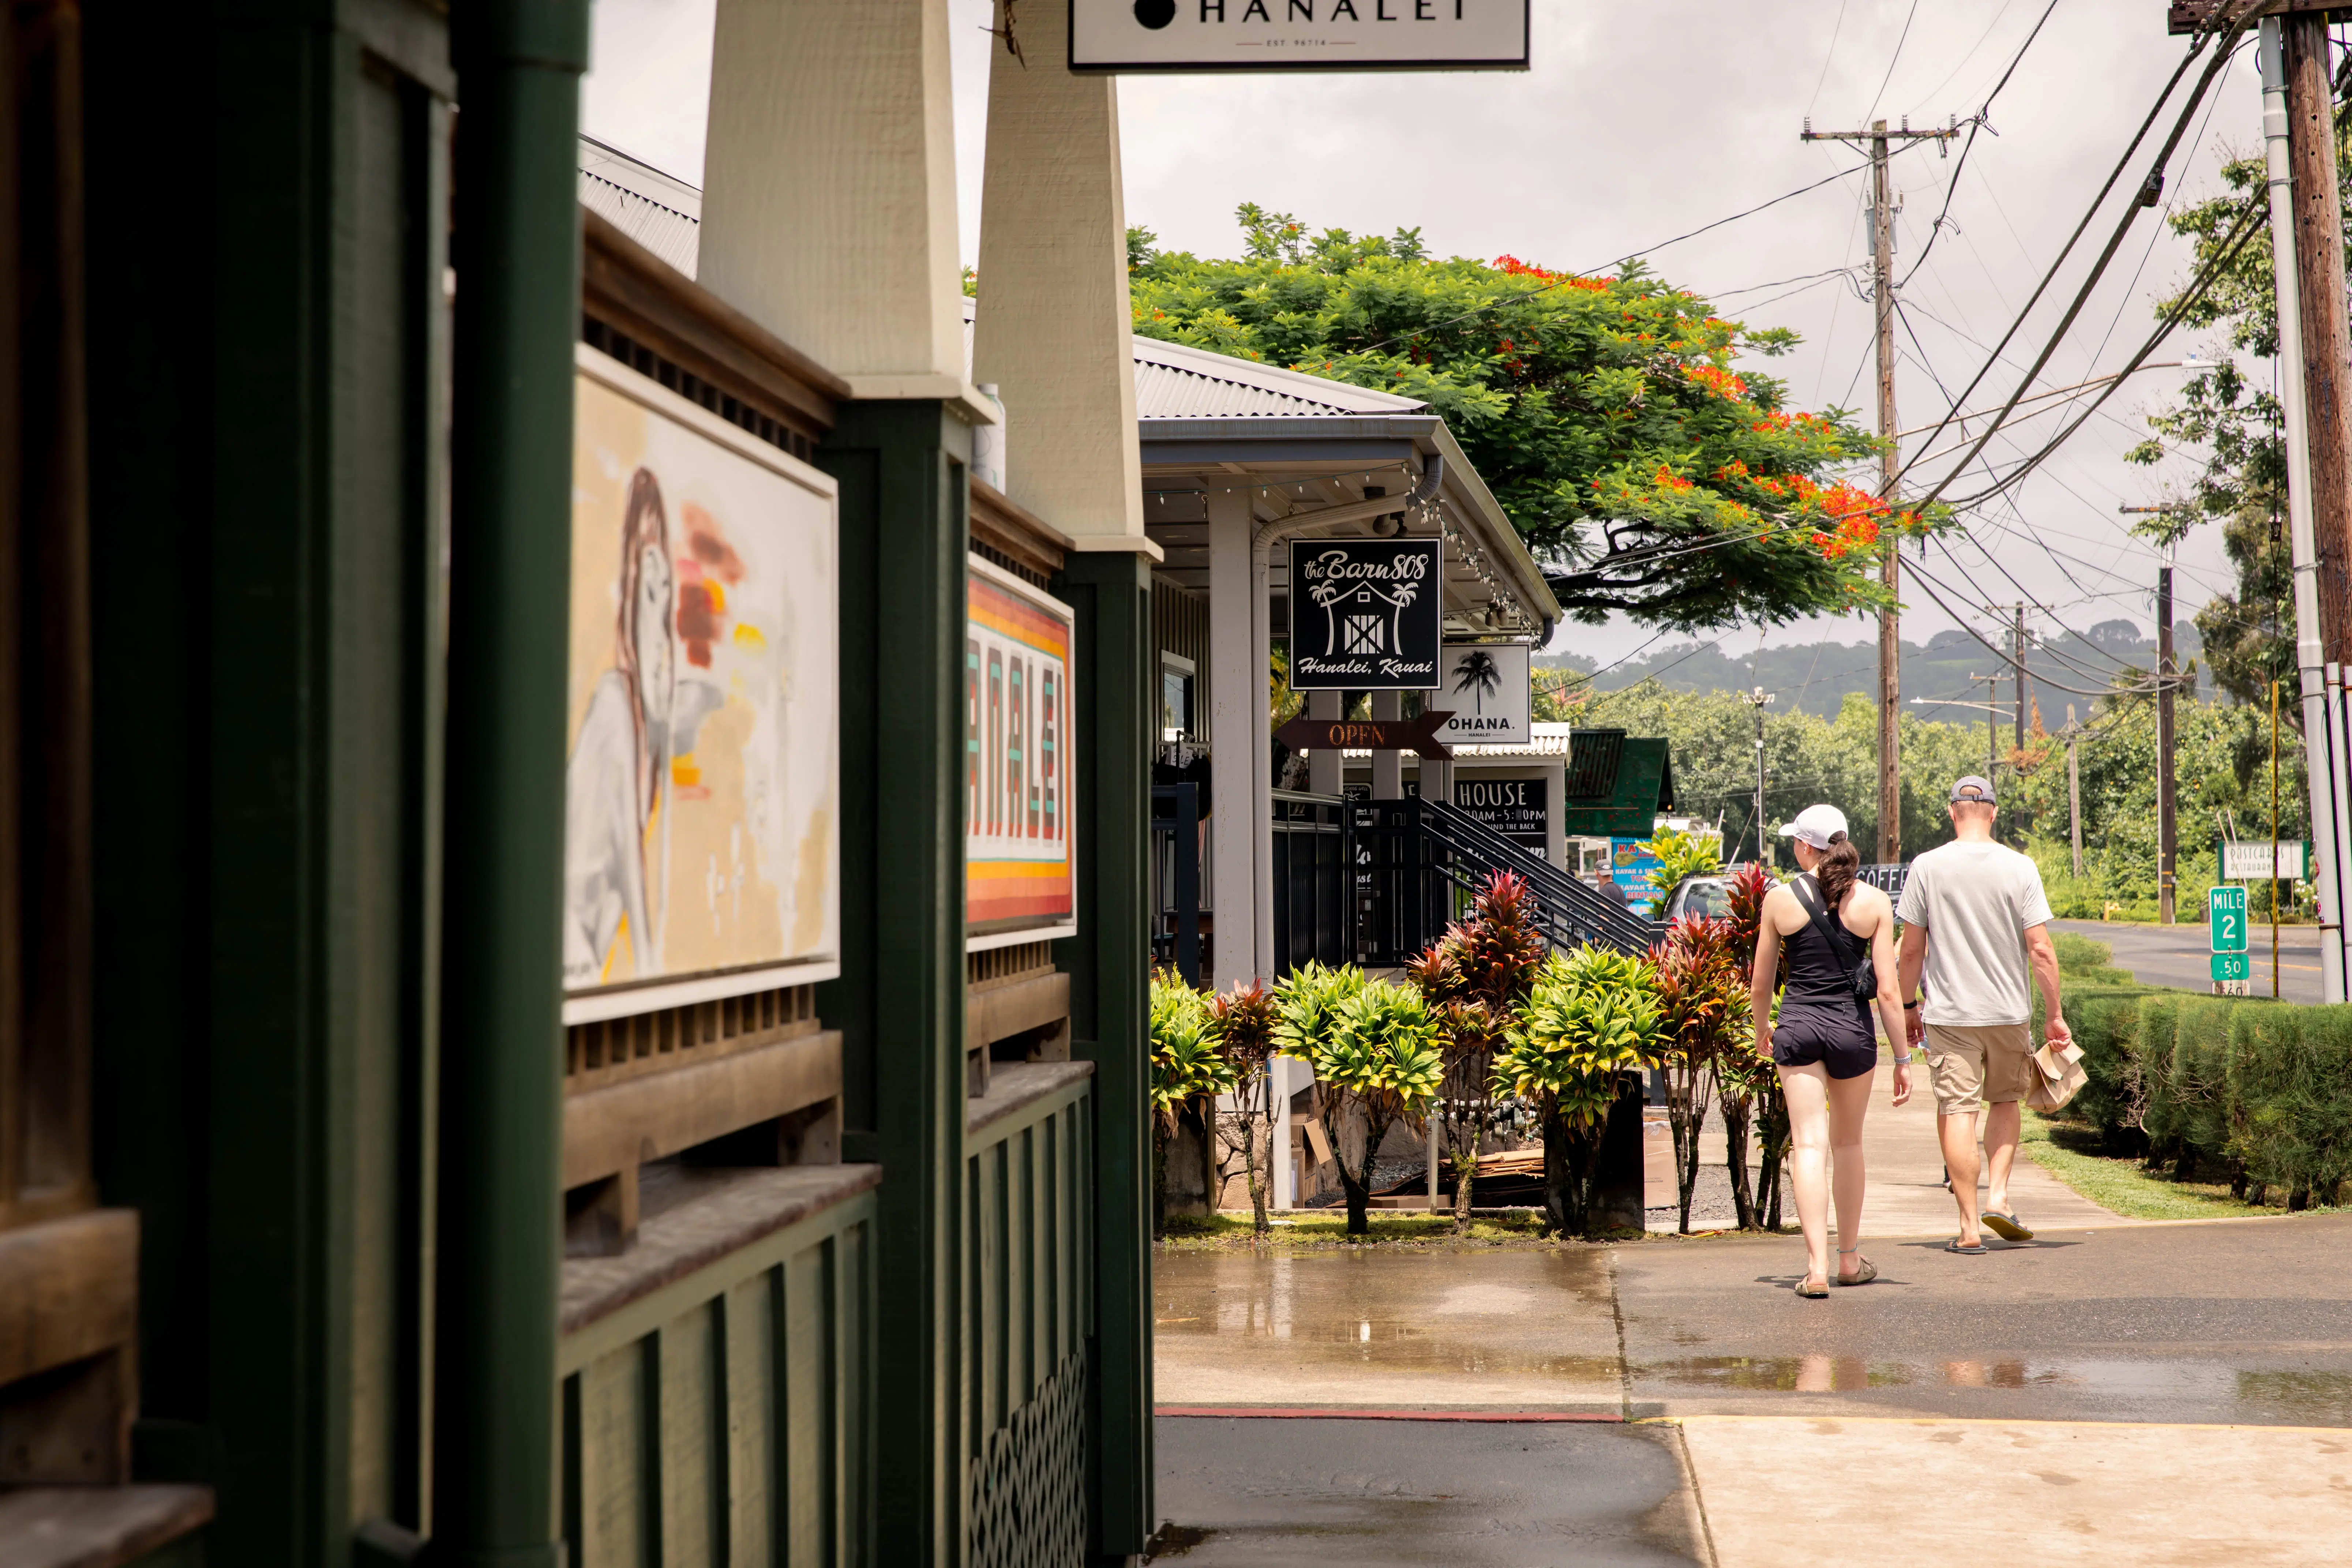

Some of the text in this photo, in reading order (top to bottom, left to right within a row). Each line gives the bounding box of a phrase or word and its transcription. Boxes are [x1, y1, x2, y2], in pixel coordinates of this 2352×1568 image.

[1199, 0, 1463, 23] HANALEI
[1304, 560, 1325, 579] the
[1298, 657, 1433, 679] Hanalei, Kauai
[1329, 724, 1385, 746] OPEN
[1172, 755, 1189, 765] SLE
[1460, 783, 1526, 806] HOUSE
[2231, 846, 2284, 859] POSTCARS
[2231, 863, 2271, 872] RESTAURAN
[2214, 893, 2243, 909] MILE
[2222, 915, 2236, 939] 2
[2220, 961, 2241, 974] .50
